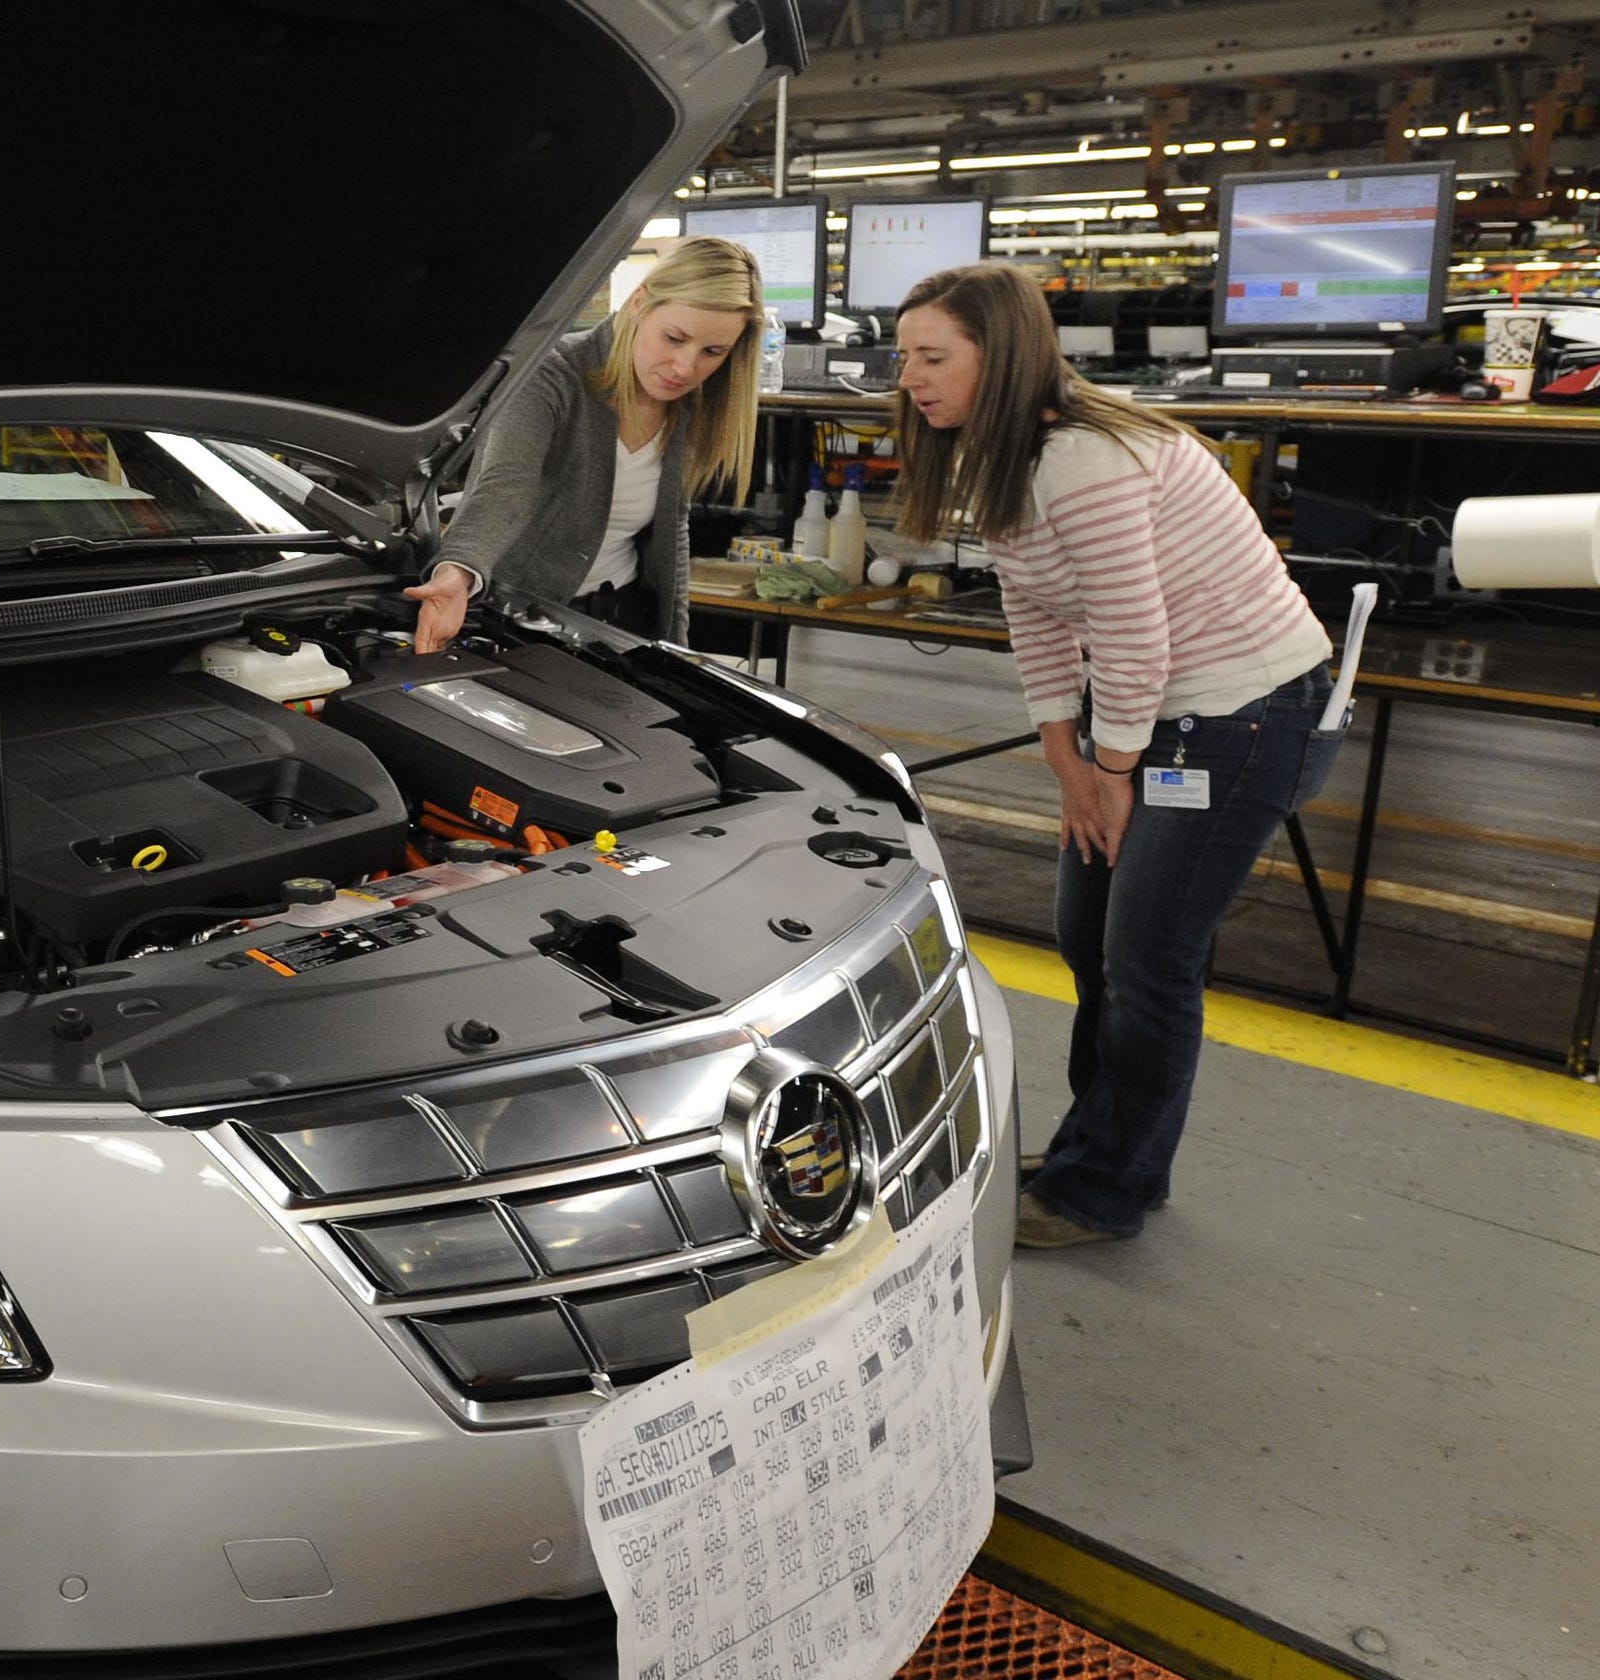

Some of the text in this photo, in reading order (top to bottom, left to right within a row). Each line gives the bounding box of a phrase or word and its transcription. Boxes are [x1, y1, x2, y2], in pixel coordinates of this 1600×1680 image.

[753, 1359, 830, 1414] CAD ELR
[753, 1380, 848, 1449] INT: BLK STYLE
[792, 1643, 817, 1675] ALU
